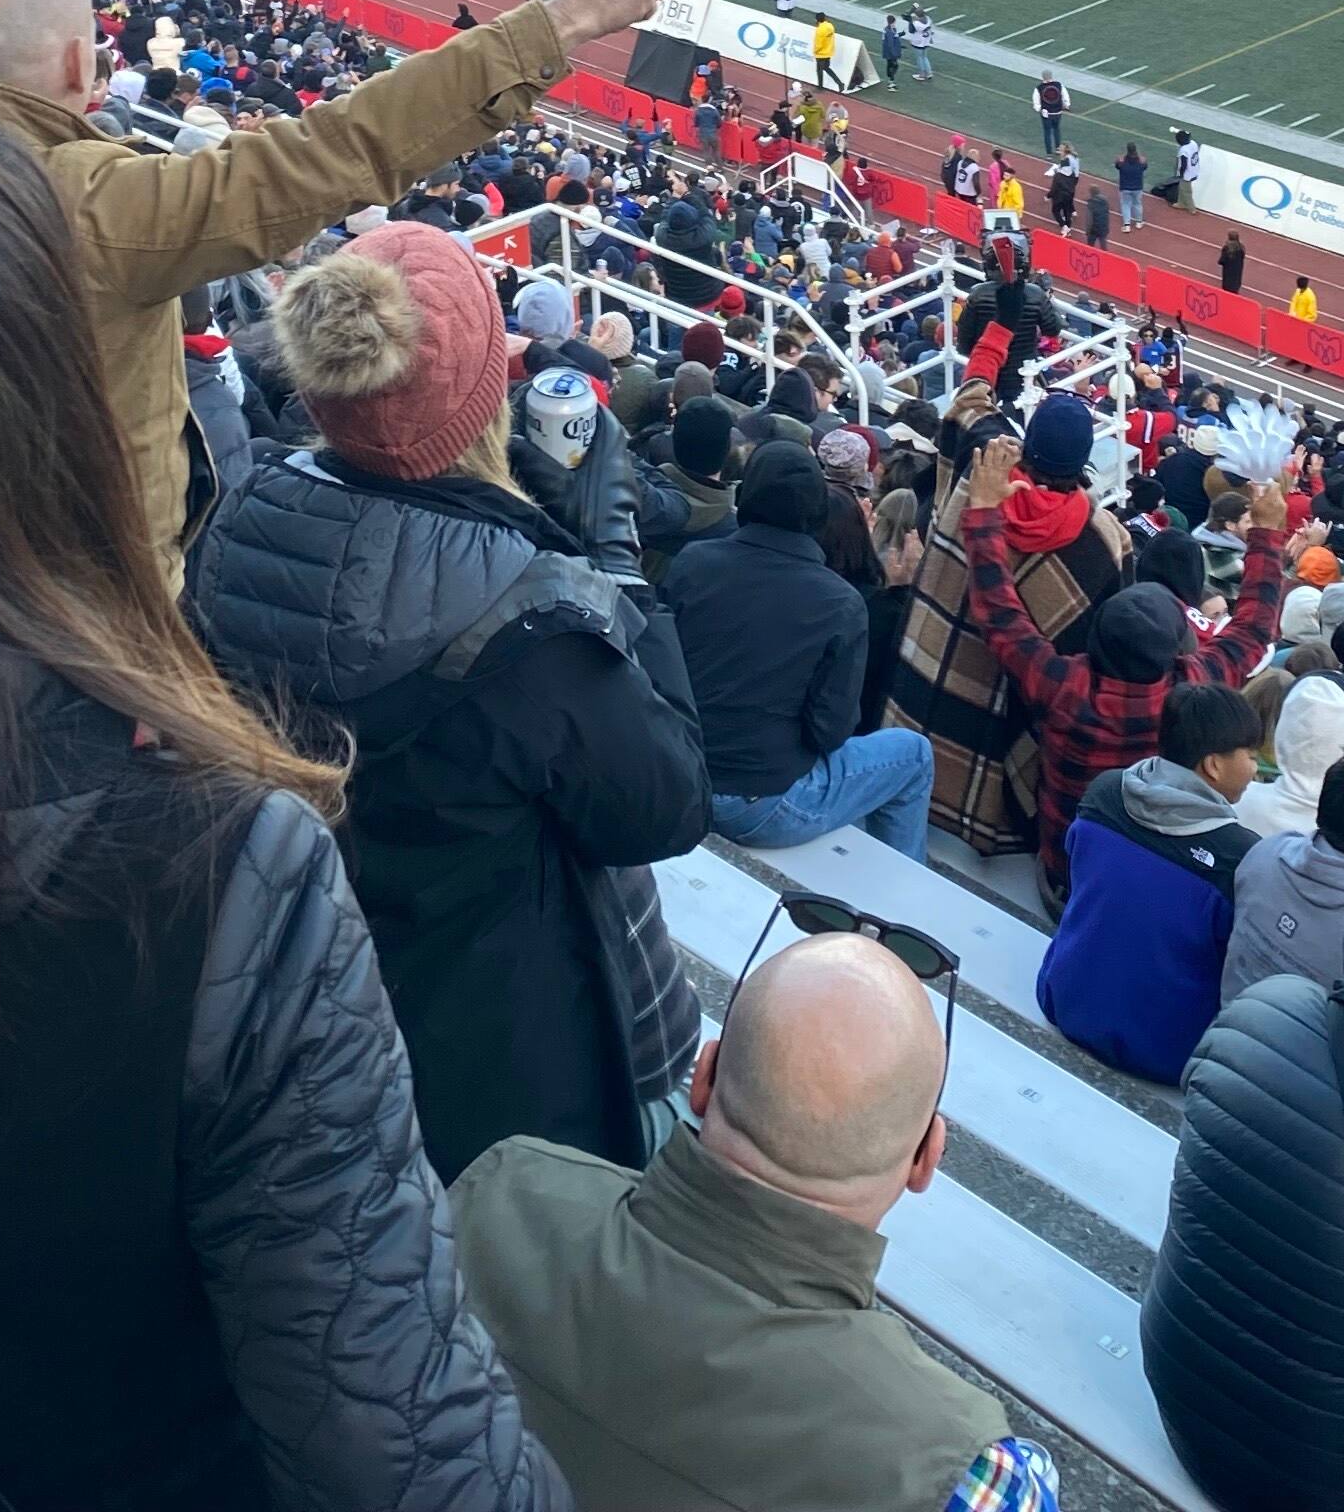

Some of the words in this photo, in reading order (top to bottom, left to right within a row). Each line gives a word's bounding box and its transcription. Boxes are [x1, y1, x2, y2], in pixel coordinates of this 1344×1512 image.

[667, 0, 697, 25] BFL
[1294, 205, 1309, 219] du
[1299, 191, 1313, 205] Le
[1314, 196, 1338, 213] parc
